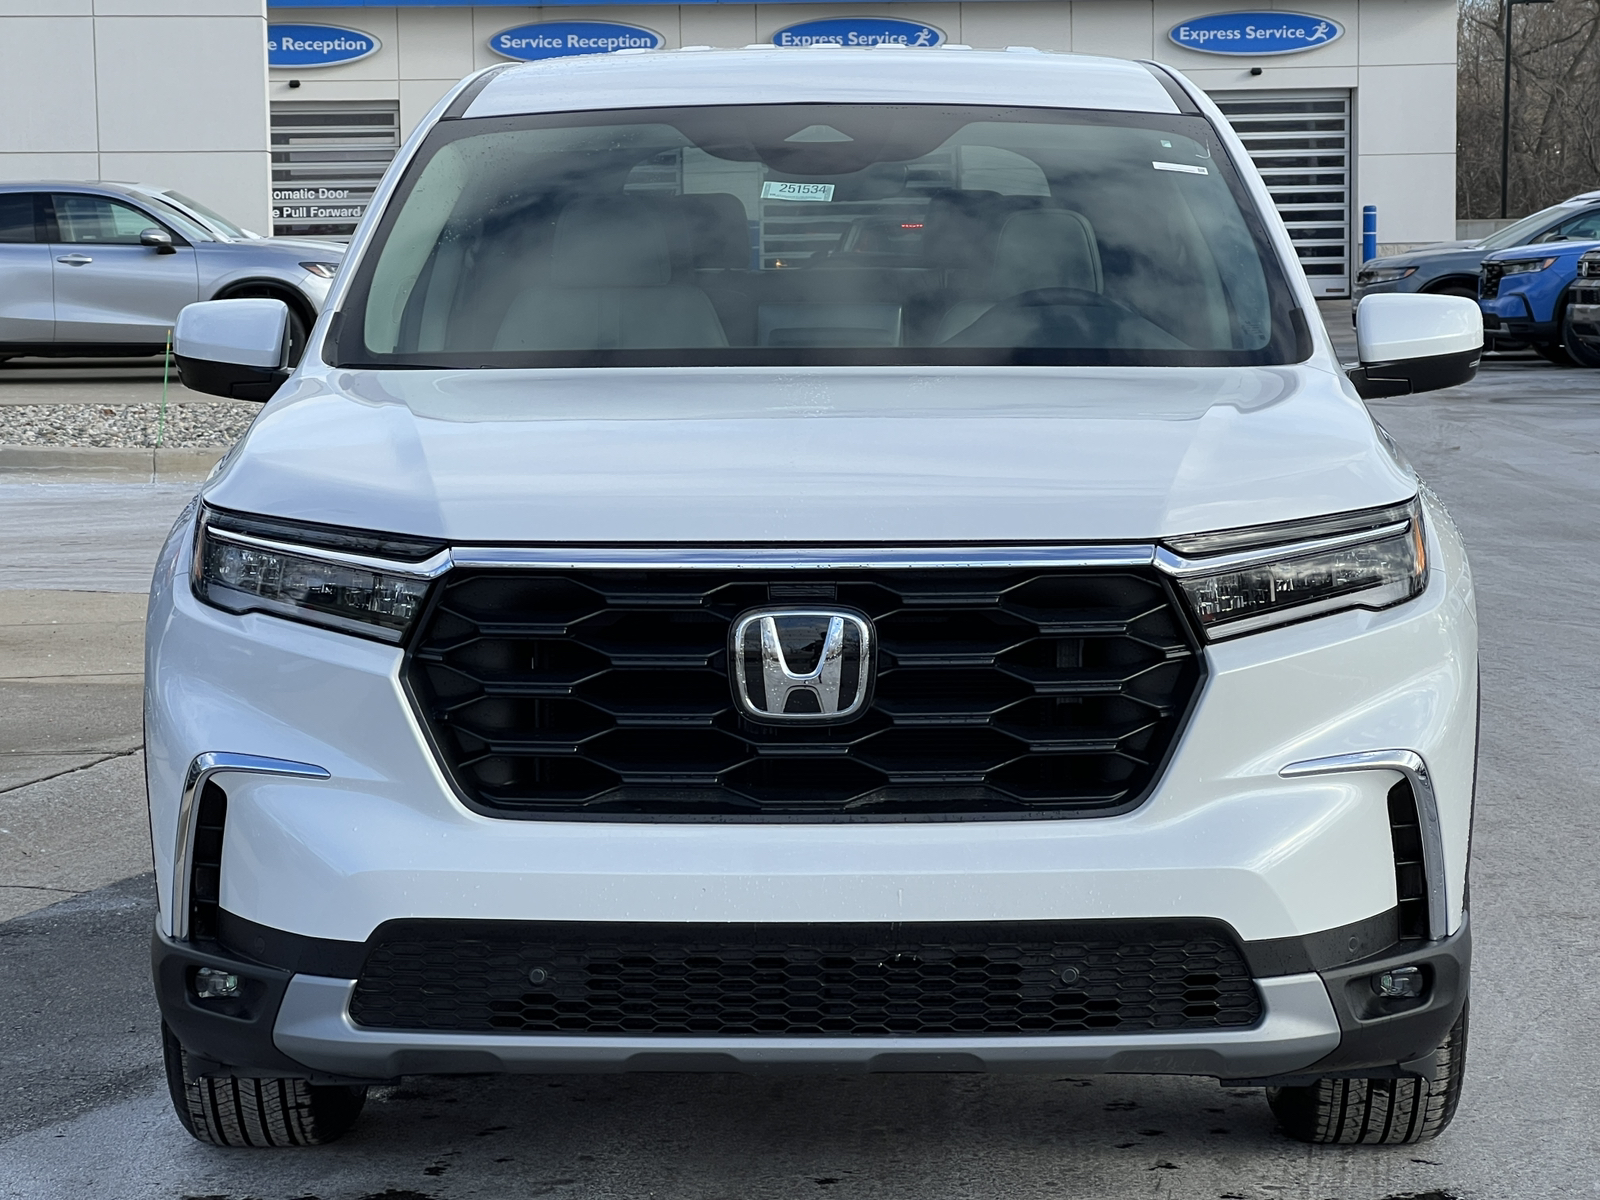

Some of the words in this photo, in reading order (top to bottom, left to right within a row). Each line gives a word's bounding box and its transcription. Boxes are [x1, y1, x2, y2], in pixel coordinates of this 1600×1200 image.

[781, 32, 844, 46] Express
[848, 31, 908, 45] Service
[1179, 26, 1241, 43] Express
[1245, 25, 1306, 39] Service
[281, 36, 367, 54] Reception
[500, 34, 562, 49] Service
[567, 34, 651, 51] Reception
[318, 188, 349, 199] Door
[778, 183, 827, 194] 251534
[282, 206, 307, 218] Pull
[310, 206, 361, 217] Forward
